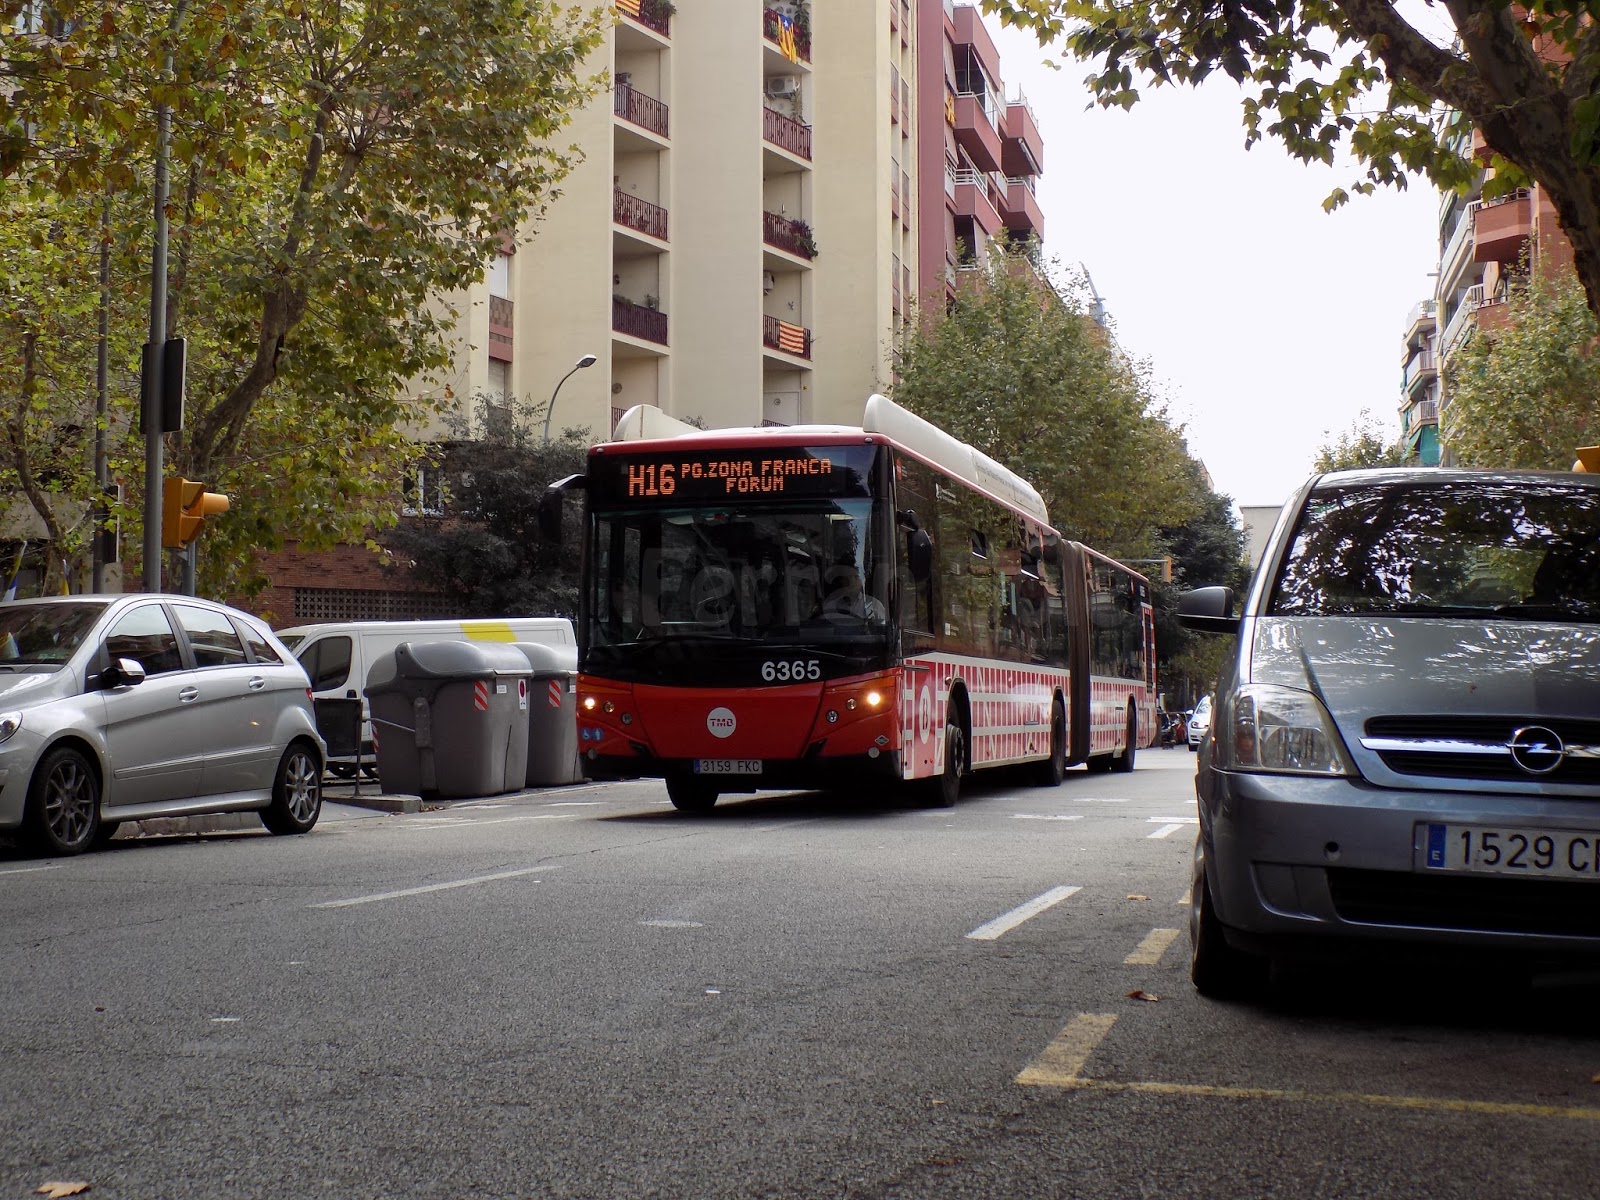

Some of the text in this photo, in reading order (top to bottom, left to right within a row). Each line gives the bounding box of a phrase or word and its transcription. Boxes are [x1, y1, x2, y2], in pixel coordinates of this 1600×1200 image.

[681, 458, 832, 478] PG.ZONA FRANCA
[628, 464, 676, 496] H16
[726, 476, 784, 493] FORUM
[761, 660, 821, 681] 6365
[710, 718, 734, 727] TMB
[702, 761, 731, 772] 3159
[737, 761, 760, 772] FKC
[1460, 830, 1600, 873] 1529 C
